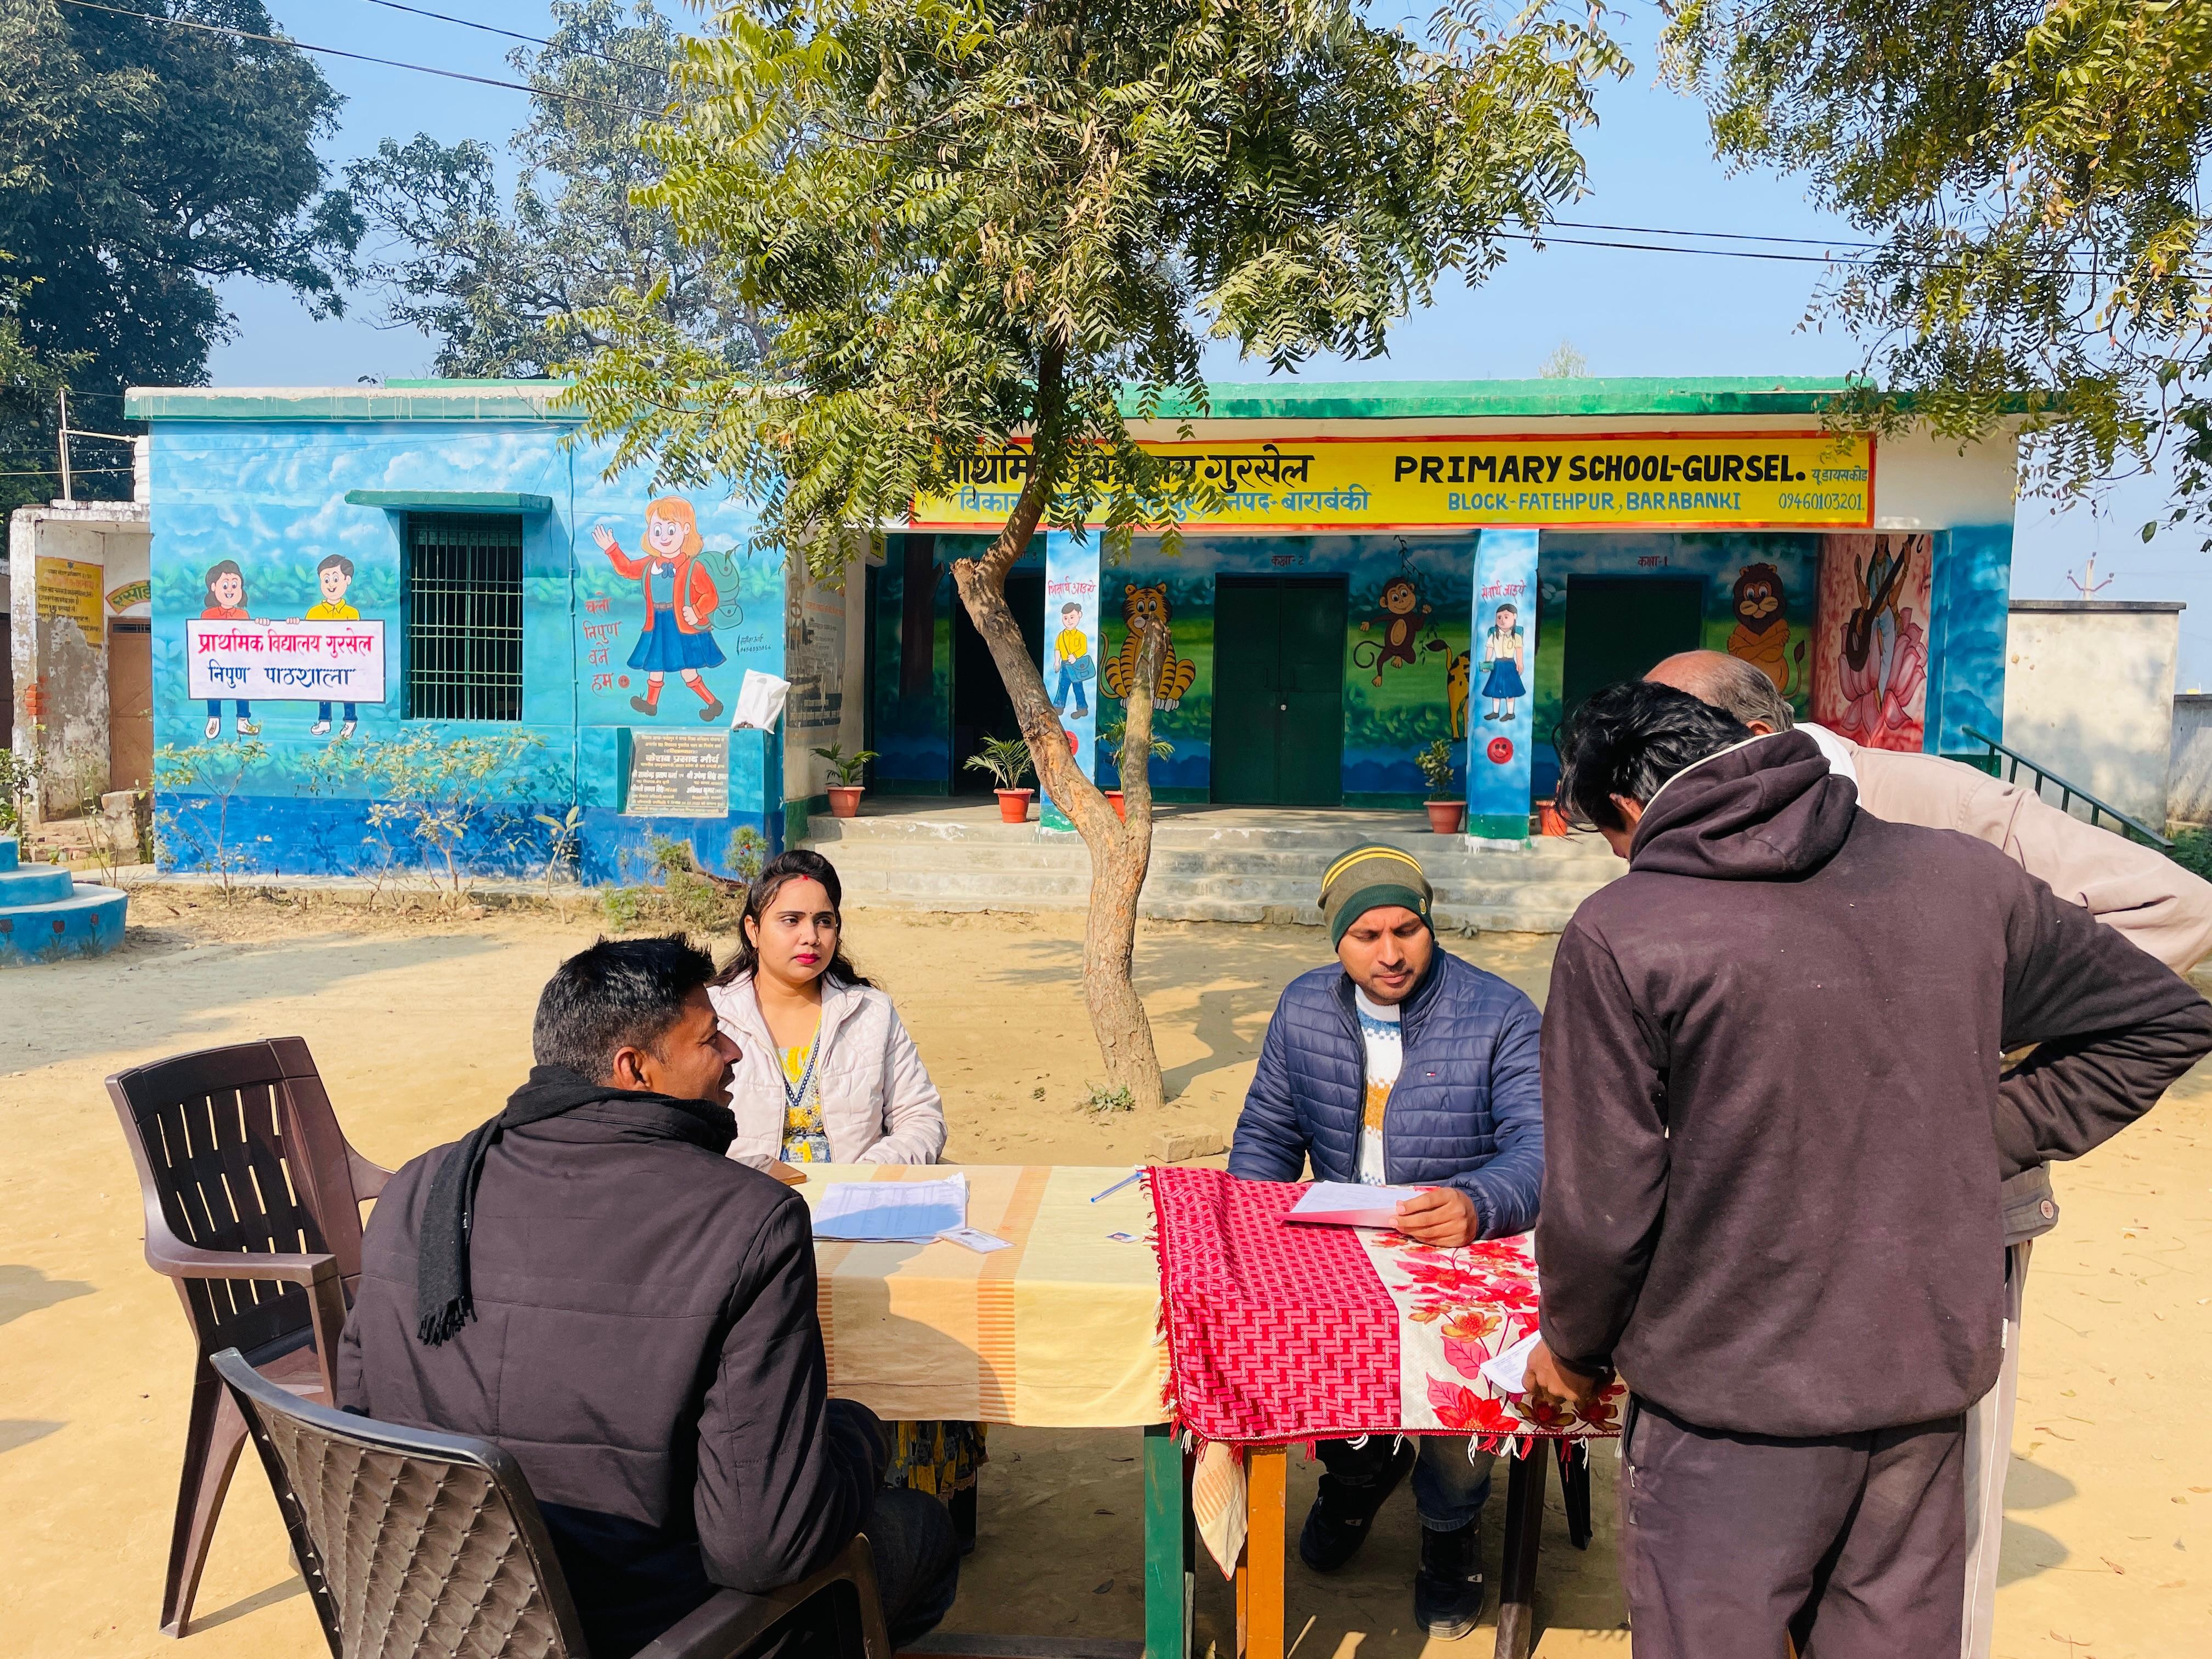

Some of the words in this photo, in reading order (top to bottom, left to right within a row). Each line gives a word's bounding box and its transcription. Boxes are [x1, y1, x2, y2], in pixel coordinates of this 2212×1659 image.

[1205, 444, 1316, 493] गुरसेल
[1395, 455, 1562, 483] PRIMARY
[1568, 455, 1805, 484] SCHOOL-GURSEL.
[1448, 492, 1623, 515] BLOCK-FATEHPUR,
[1626, 492, 1741, 511] BARABANKI
[585, 591, 614, 617] चलो
[198, 628, 263, 653] प्राथमिक
[268, 629, 322, 656] विद्यालय
[326, 628, 374, 658] गुरसेल
[583, 620, 623, 644] निपुण
[589, 642, 611, 667] बने
[207, 659, 251, 688] निपुण
[264, 667, 357, 687] पाठशाला
[591, 672, 614, 697] हम
[645, 753, 670, 762] केशव
[673, 755, 699, 763] प्रसाद
[700, 753, 720, 764] मौर्य
